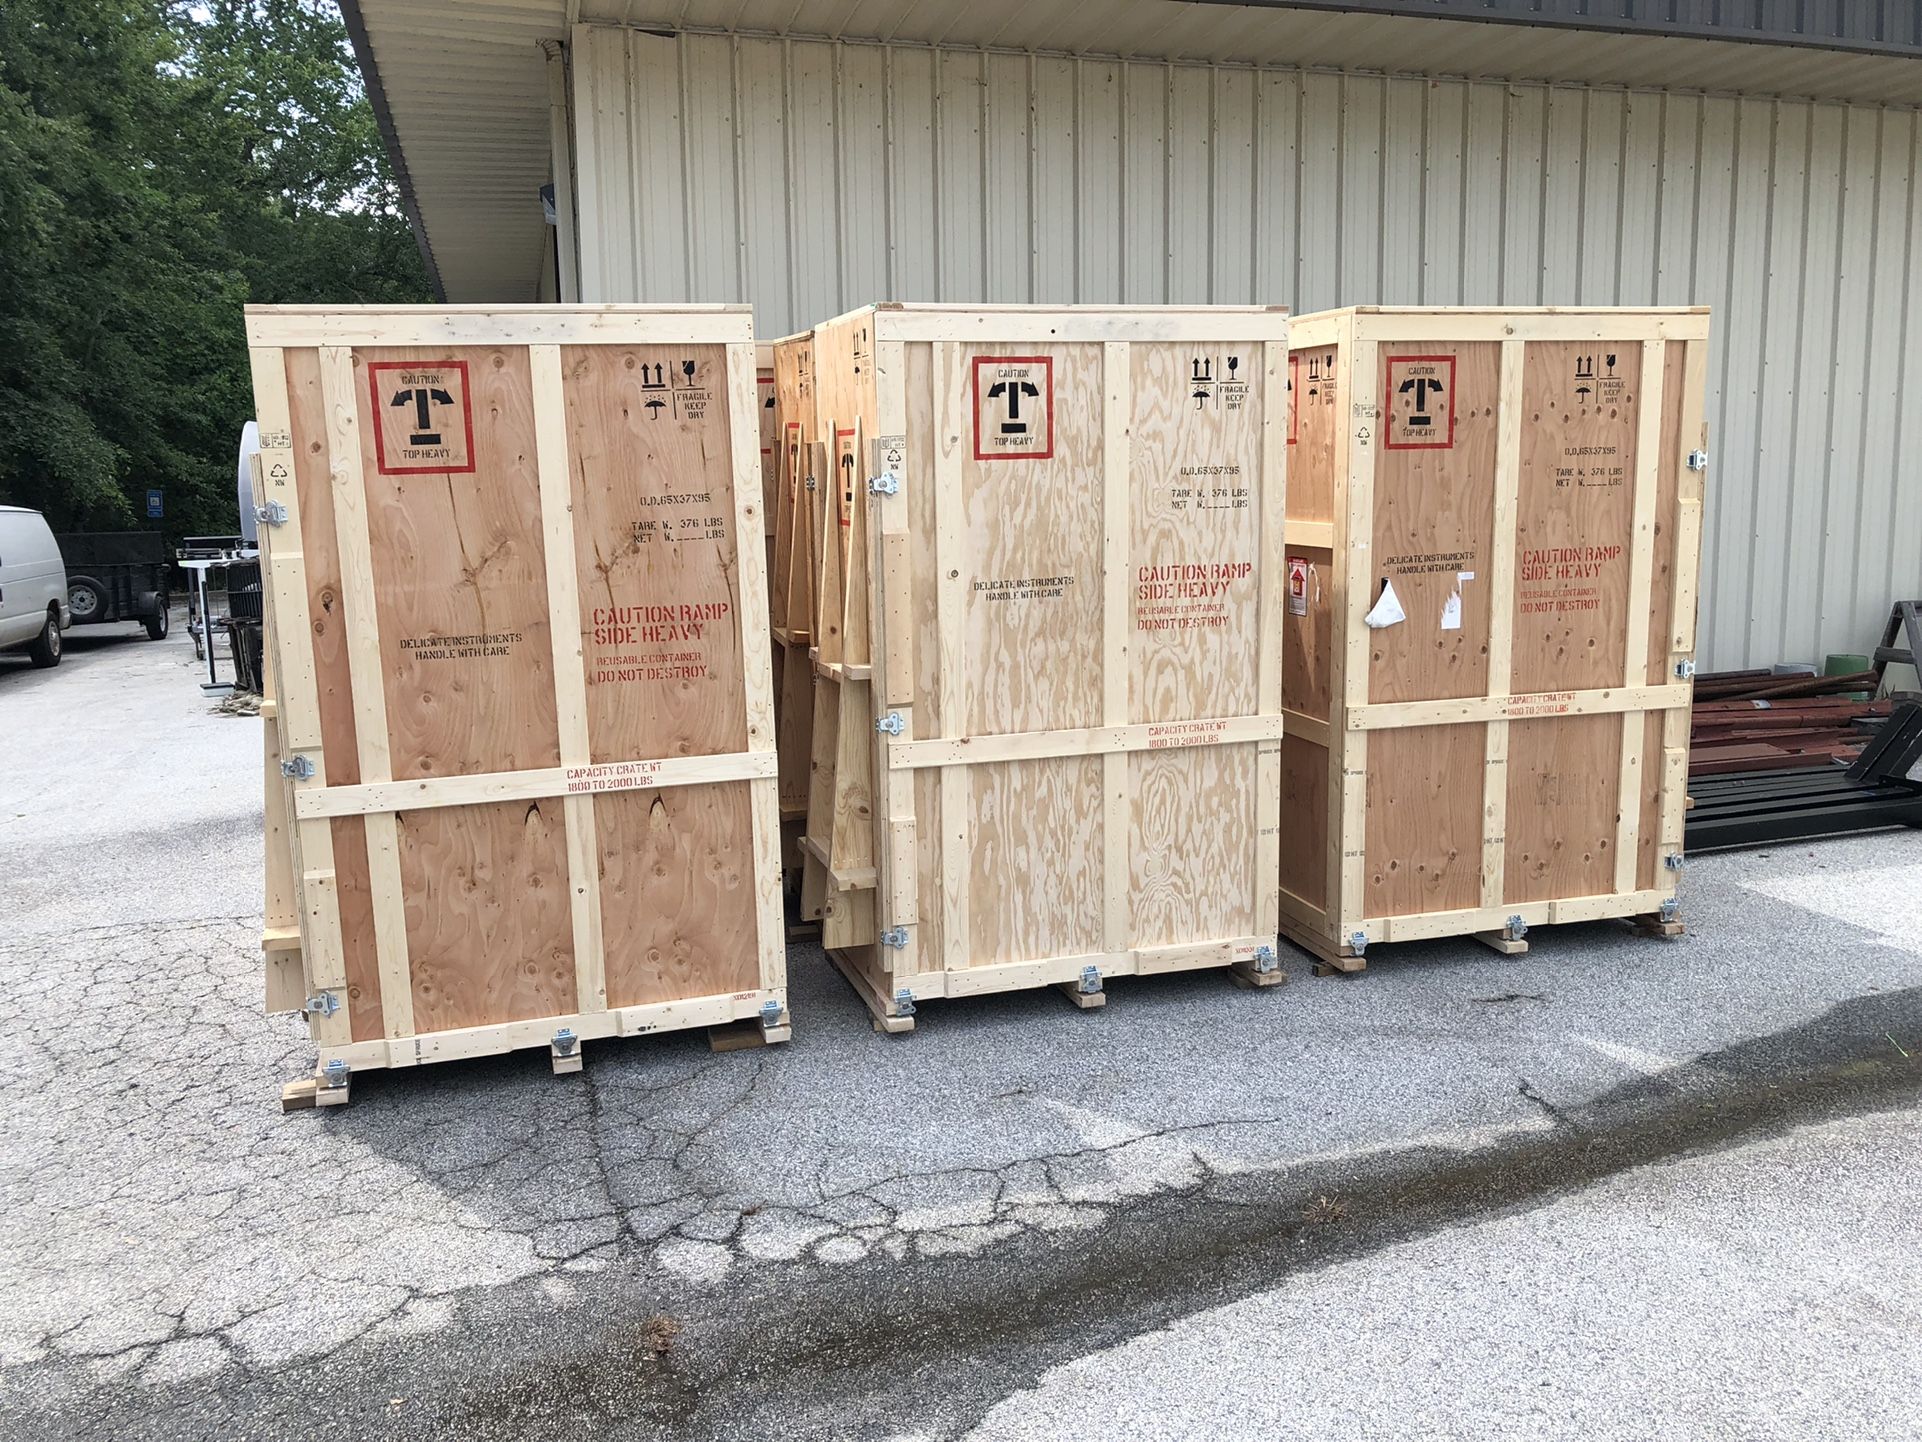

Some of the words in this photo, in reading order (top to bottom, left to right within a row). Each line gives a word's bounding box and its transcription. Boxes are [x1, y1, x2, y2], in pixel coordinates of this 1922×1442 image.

[401, 375, 440, 385] CAUTION
[998, 369, 1029, 378] CAUTION
[1220, 385, 1249, 393] FRAGILE
[677, 392, 712, 401] FRAGILE
[684, 402, 706, 410] KEEP
[688, 411, 704, 419] DRY
[1403, 428, 1415, 437] TOP
[1415, 428, 1436, 436] HEAVY
[994, 437, 1008, 446] TOP
[1009, 437, 1033, 445] HEAVY
[402, 450, 420, 459] TOP
[421, 449, 451, 458] HEAVY
[1556, 468, 1574, 477] TARE
[1591, 467, 1605, 476] 376
[1608, 467, 1623, 475] LBS
[1556, 479, 1570, 487] NET
[1171, 489, 1192, 498] TARE
[1212, 488, 1227, 497] 376
[1231, 488, 1247, 497] LBS
[1171, 501, 1187, 509] NET
[632, 521, 656, 531] TARE
[680, 518, 699, 528] 376
[704, 517, 723, 527] LBS
[633, 533, 652, 543] NET
[1386, 554, 1423, 565] DELICATE
[1424, 551, 1475, 562] INSTRUMENTS
[1523, 547, 1581, 564] CAUTION
[1585, 545, 1620, 561] RAMP
[1138, 564, 1206, 582] CAUTION
[1211, 562, 1252, 579] RAMP
[1396, 565, 1426, 575] HANDLE
[1427, 564, 1444, 572] WITH
[1445, 562, 1464, 571] CARE
[1522, 565, 1551, 580] SIDE
[1556, 563, 1601, 579] HEAVY
[973, 580, 1015, 590] DELICATE
[1016, 576, 1074, 588] INSTRUMENTS
[985, 591, 1019, 601] HANDLE
[1020, 590, 1040, 599] WITH
[1041, 588, 1063, 597] CARE
[1139, 583, 1173, 600] SIDE
[1178, 581, 1230, 598] HEAVY
[1520, 590, 1557, 599] REUSABLE
[1558, 588, 1597, 598] CONTAINER
[1137, 605, 1179, 615] REUSABLE
[1181, 603, 1225, 613] CONTAINER
[1520, 602, 1533, 613] DO
[1534, 601, 1554, 613] NOT
[1556, 599, 1600, 611] DESTROY
[593, 605, 675, 626] CAUTION
[680, 603, 728, 621] RAMP
[1138, 620, 1151, 630] DO
[1154, 618, 1176, 630] NOT
[1178, 616, 1229, 629] DESTROY
[595, 627, 637, 645] SIDE
[642, 623, 703, 642] HEAVY
[400, 637, 450, 649] DELICATE
[451, 633, 523, 646] INSTRUMENTS
[415, 649, 456, 660] HANDLE
[458, 647, 481, 658] WITH
[483, 646, 509, 656] CARE
[596, 655, 647, 666] REUSABLE
[649, 652, 702, 663] CONTAINER
[597, 670, 614, 683] DO
[618, 668, 643, 681] NOT
[647, 665, 707, 680] DESTROY
[1508, 696, 1542, 705] CAPACITY
[1543, 693, 1566, 702] CRATE
[1526, 706, 1534, 715] TO
[1535, 705, 1553, 714] 2000
[1555, 704, 1568, 712] LBS
[1148, 725, 1187, 736] CAPACITY
[1189, 722, 1215, 732] CRATE
[1216, 721, 1226, 730] WT
[1149, 739, 1167, 748] 1800
[1169, 738, 1179, 746] TO
[1181, 736, 1202, 745] 2000
[1203, 734, 1218, 743] LBS
[567, 767, 614, 779] CAPACITY
[616, 764, 648, 775] CRATE
[650, 762, 662, 772] WT
[568, 781, 590, 792] 1800
[593, 780, 605, 790] TO
[608, 777, 632, 789] 2000
[634, 776, 653, 786] LBS
